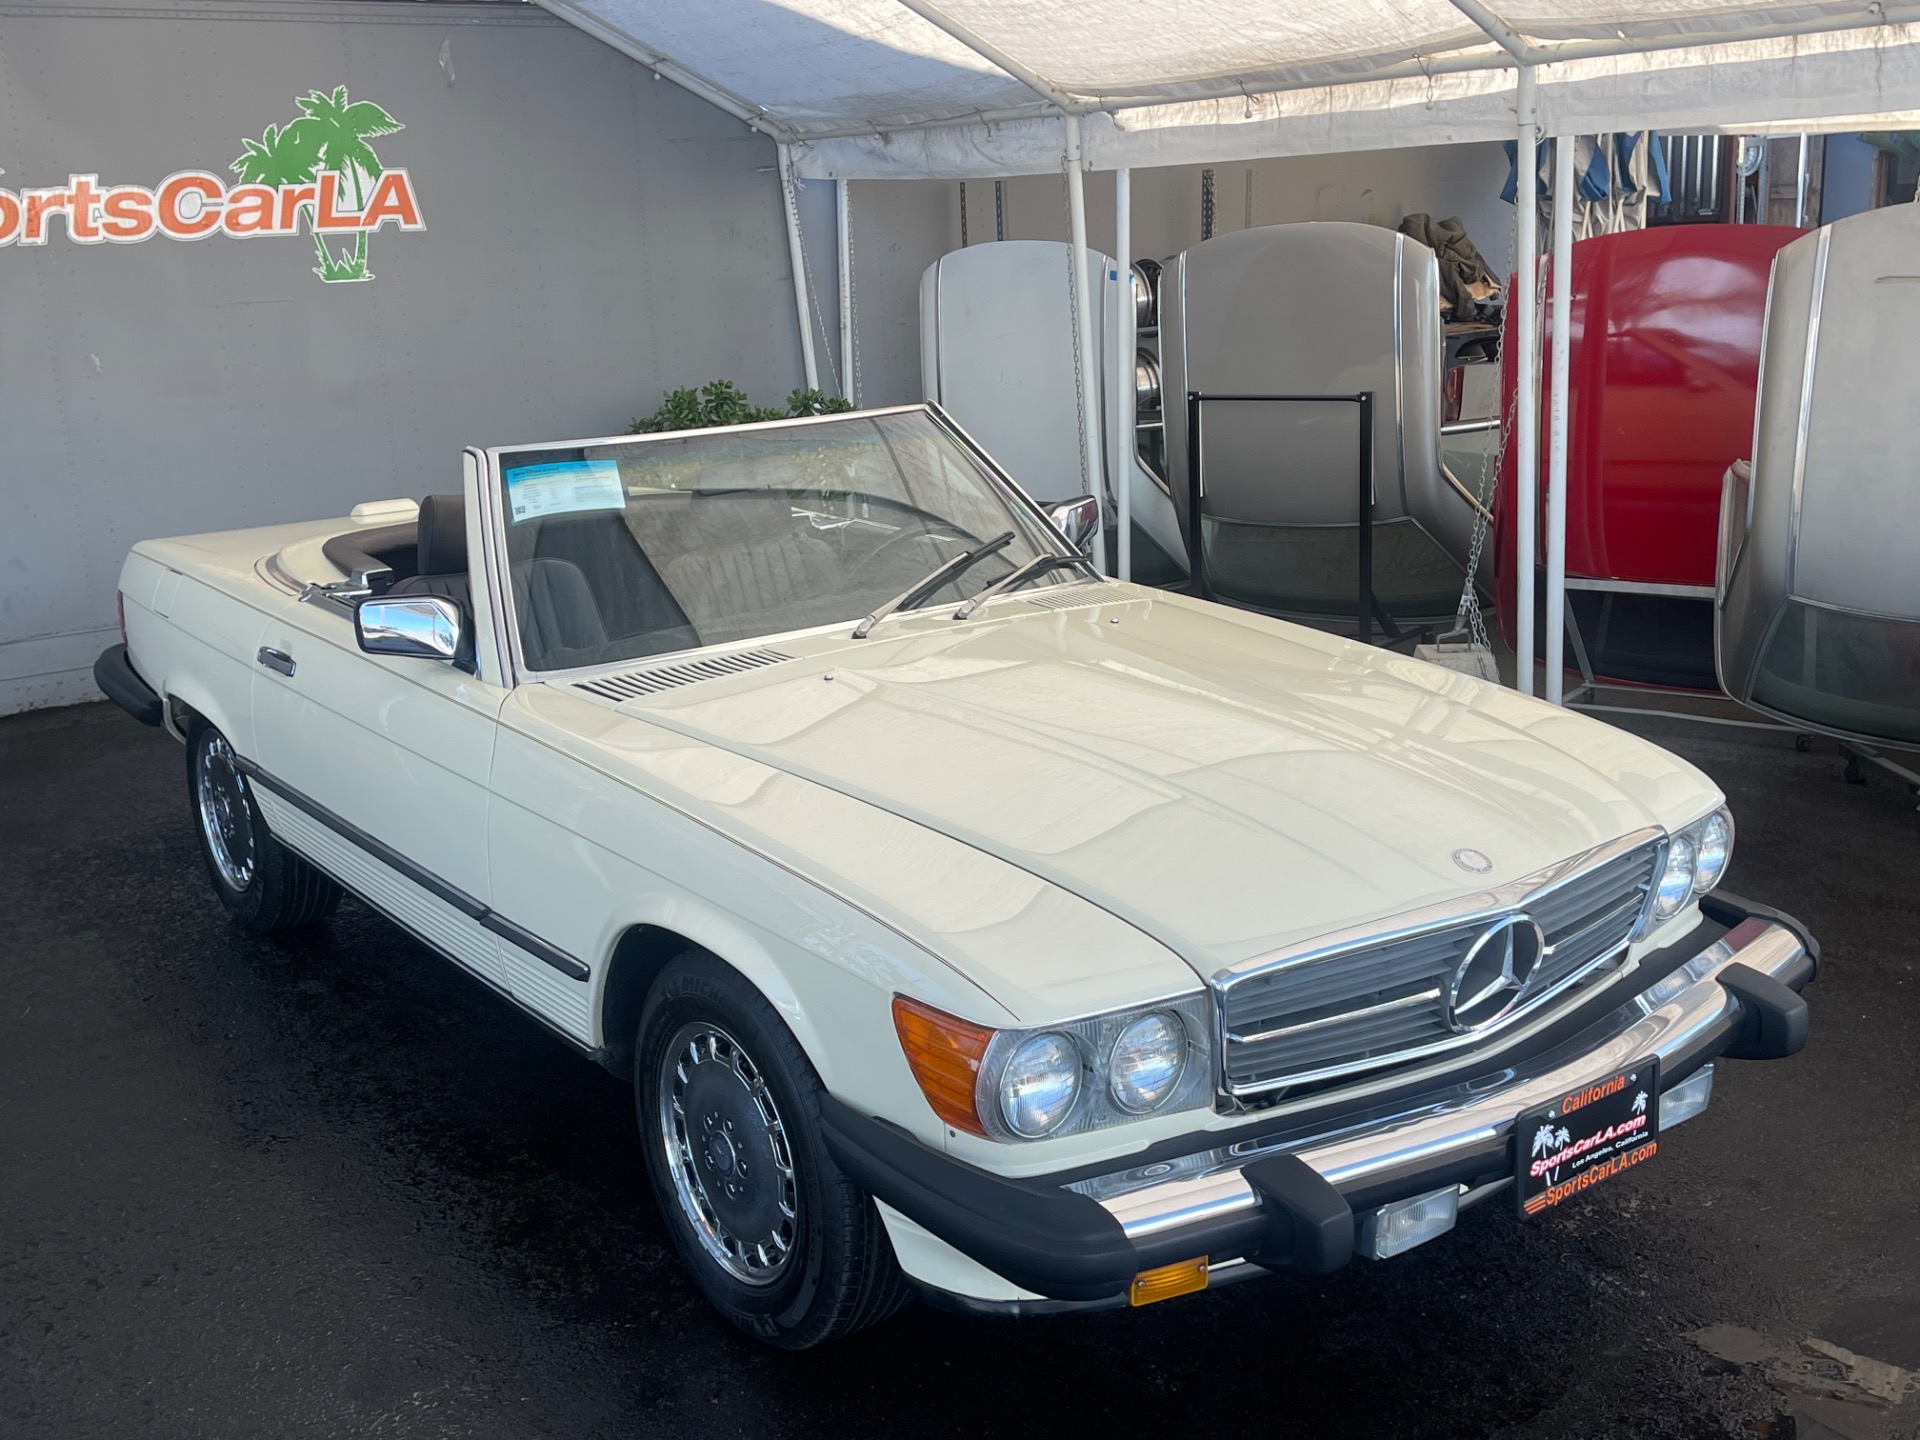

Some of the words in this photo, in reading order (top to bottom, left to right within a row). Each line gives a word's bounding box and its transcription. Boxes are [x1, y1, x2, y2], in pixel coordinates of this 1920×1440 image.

[1561, 1075, 1625, 1114] California
[1530, 1114, 1646, 1177] SportsCarLA.com
[1572, 1158, 1585, 1169] Los
[1615, 1131, 1649, 1149] California
[1546, 1141, 1658, 1206] SportsCarLA.com
